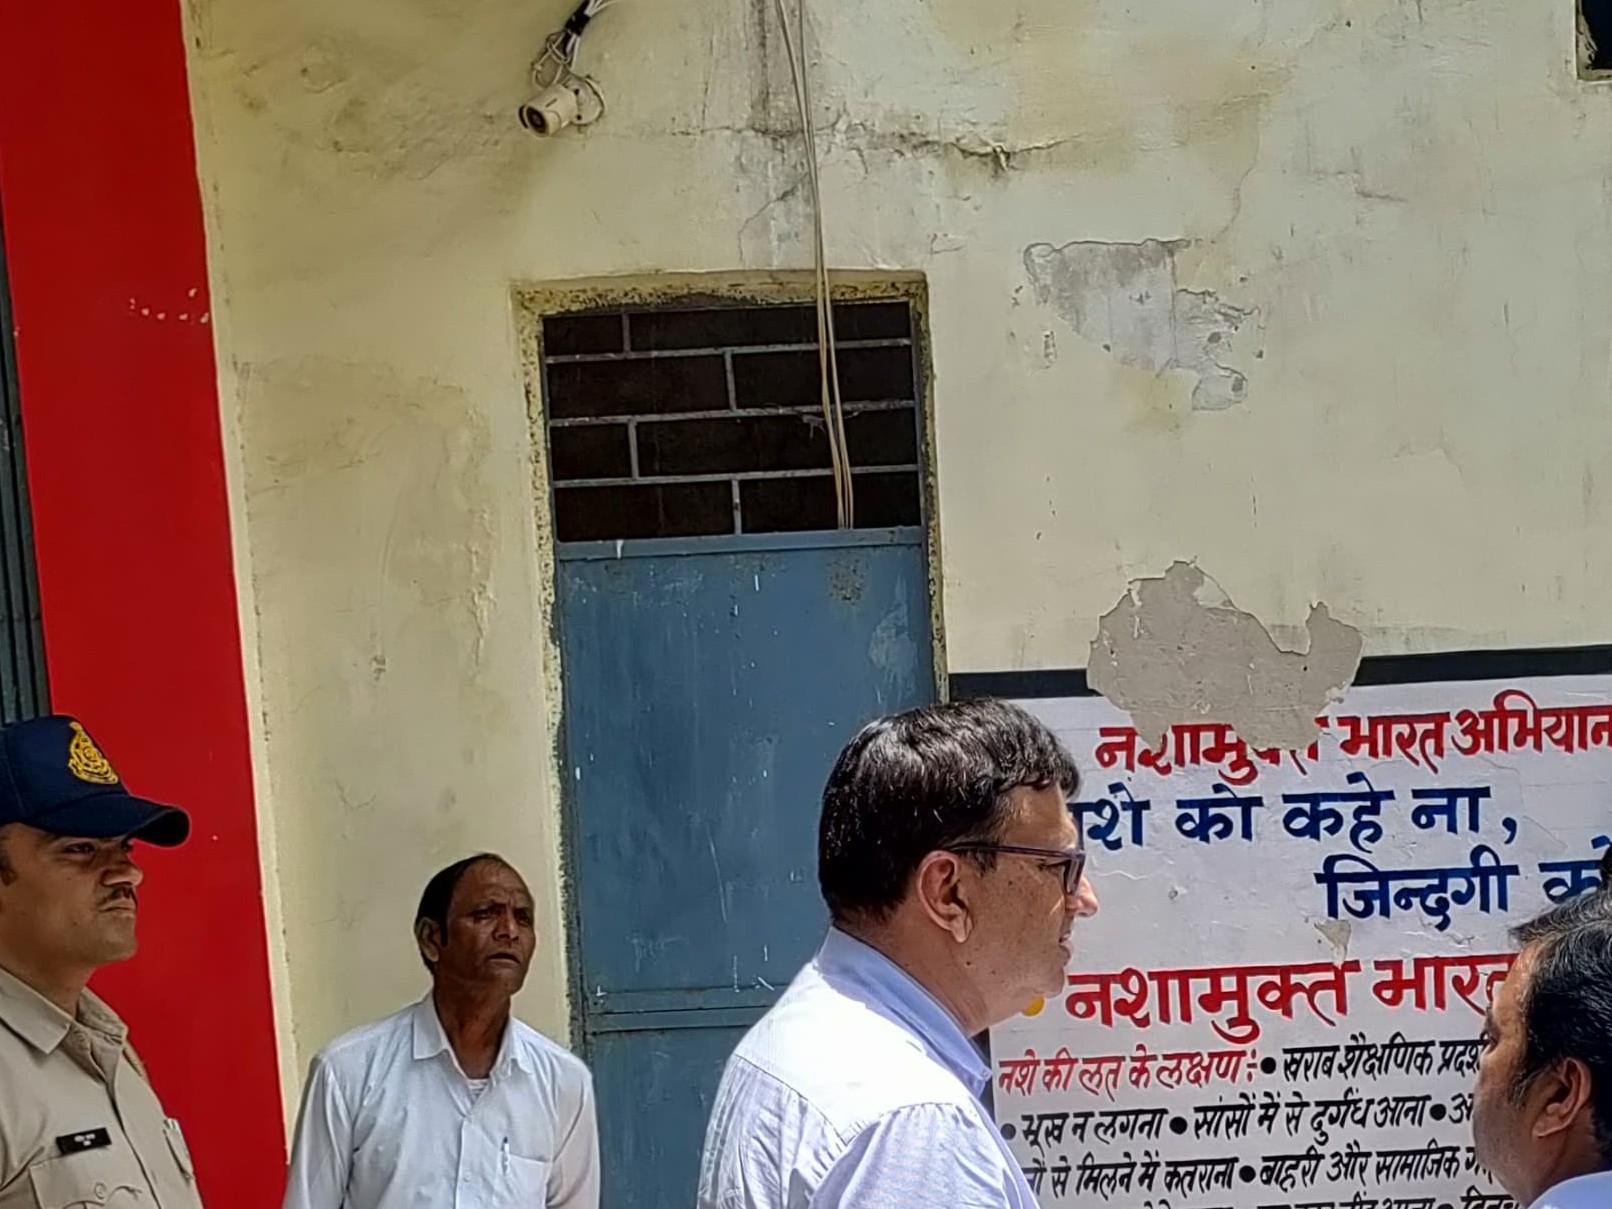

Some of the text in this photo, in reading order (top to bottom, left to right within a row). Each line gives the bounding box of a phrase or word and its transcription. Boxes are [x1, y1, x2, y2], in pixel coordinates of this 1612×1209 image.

[1336, 711, 1451, 775] भारत
[1174, 783, 1264, 844] को
[1281, 771, 1396, 854] कहे
[1410, 786, 1518, 845] ना,
[1313, 843, 1520, 932] जिन्दगी
[1066, 960, 1361, 1043] नशामुक्त
[998, 1048, 1041, 1097] नशे
[1041, 1046, 1079, 1092] की
[1079, 1055, 1126, 1102] लत
[1128, 1043, 1158, 1090] के
[1282, 1044, 1341, 1082] खराब
[1337, 1031, 1436, 1081] शैक्षणिक
[1020, 1111, 1070, 1158] भूख
[1071, 1110, 1095, 1144] न
[1093, 1107, 1170, 1145] लगना
[1193, 1092, 1256, 1141] सांसों
[1257, 1090, 1281, 1135] में
[1284, 1090, 1311, 1138] से
[1373, 1094, 1433, 1128] आना
[1050, 1154, 1072, 1199] से
[1075, 1151, 1138, 1201] मिलने
[1137, 1149, 1162, 1192] में
[1163, 1156, 1240, 1199] कतराना
[1259, 1145, 1326, 1193] बाहरी
[1326, 1139, 1373, 1187] और
[1374, 1137, 1461, 1186] सामाजिक
